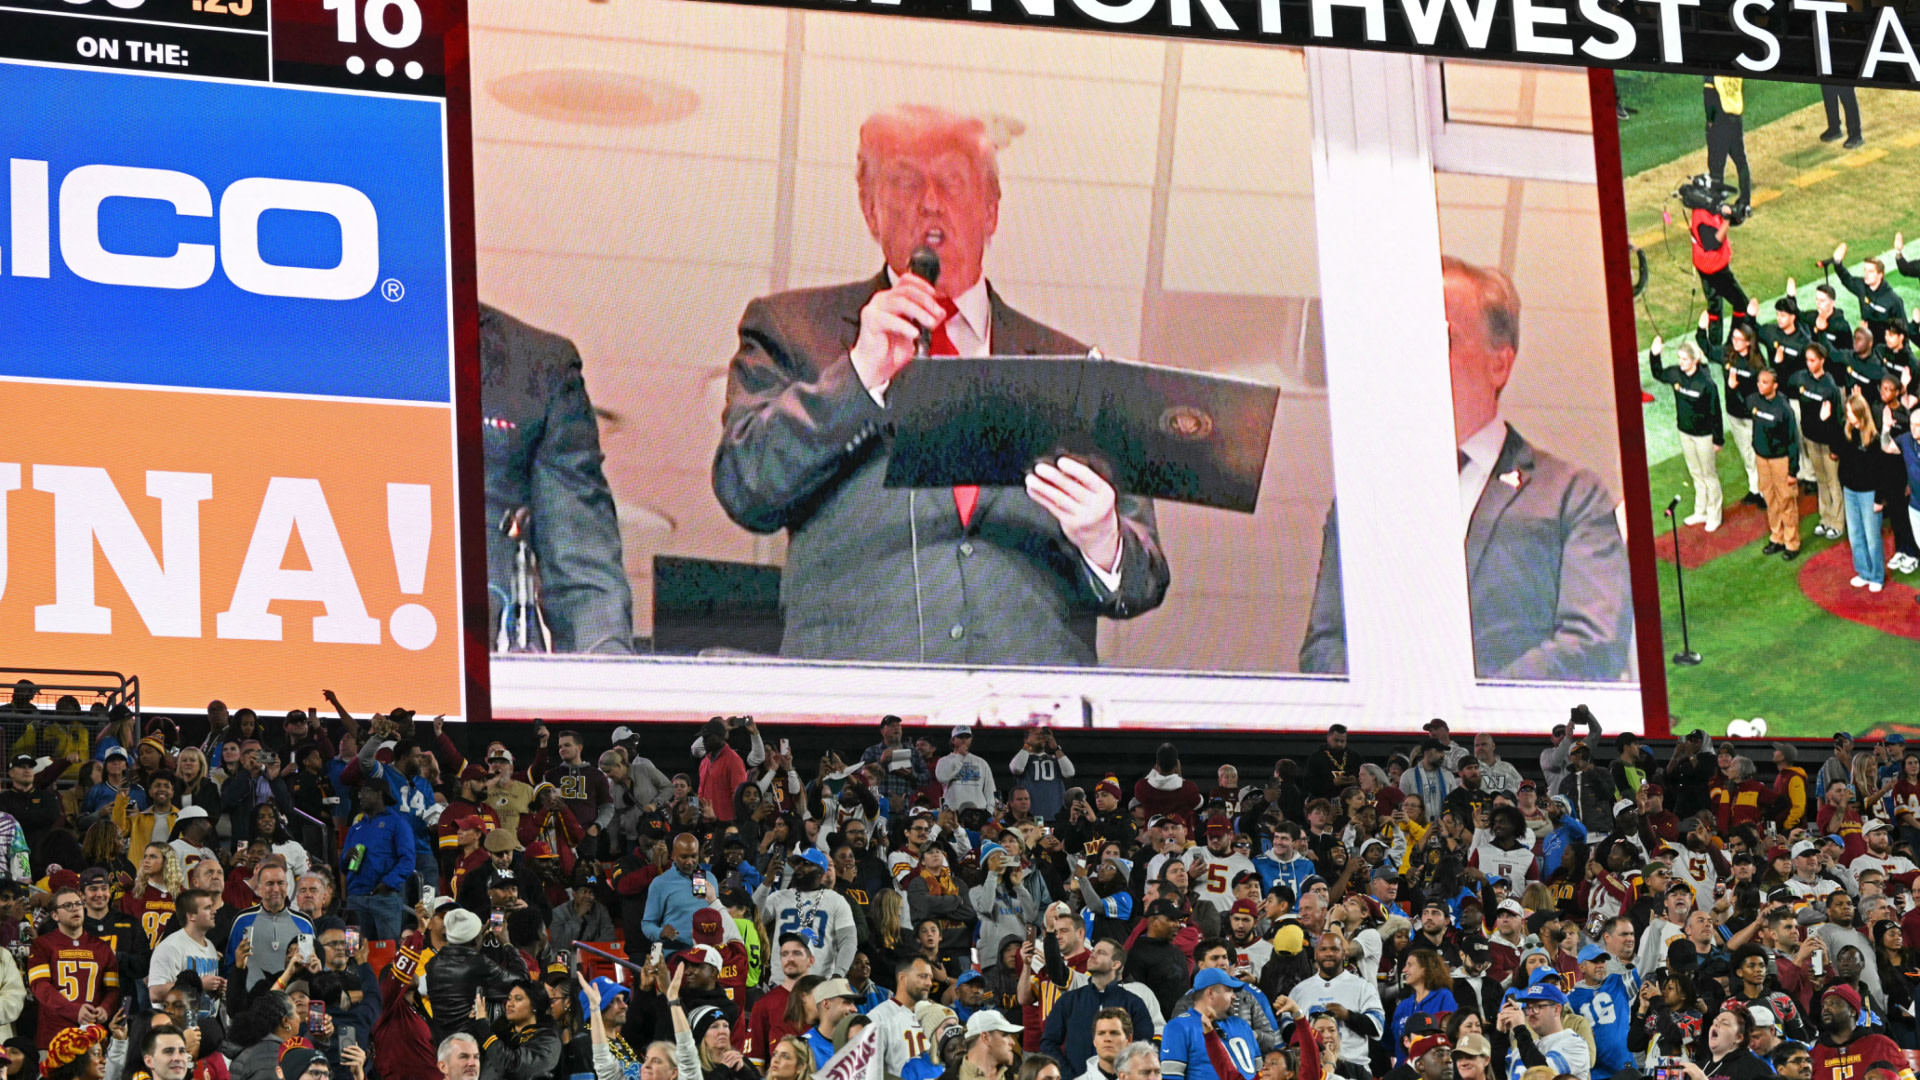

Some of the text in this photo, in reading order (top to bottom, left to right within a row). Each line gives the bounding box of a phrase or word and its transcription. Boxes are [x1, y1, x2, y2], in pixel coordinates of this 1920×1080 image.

[76, 36, 189, 67] ON THE:
[0, 157, 380, 300] ICO
[1031, 758, 1056, 781] 10
[398, 785, 425, 814] 14
[560, 775, 588, 800] 21
[1206, 863, 1229, 894] 5
[1688, 857, 1707, 882] 5
[56, 960, 99, 1003] 57
